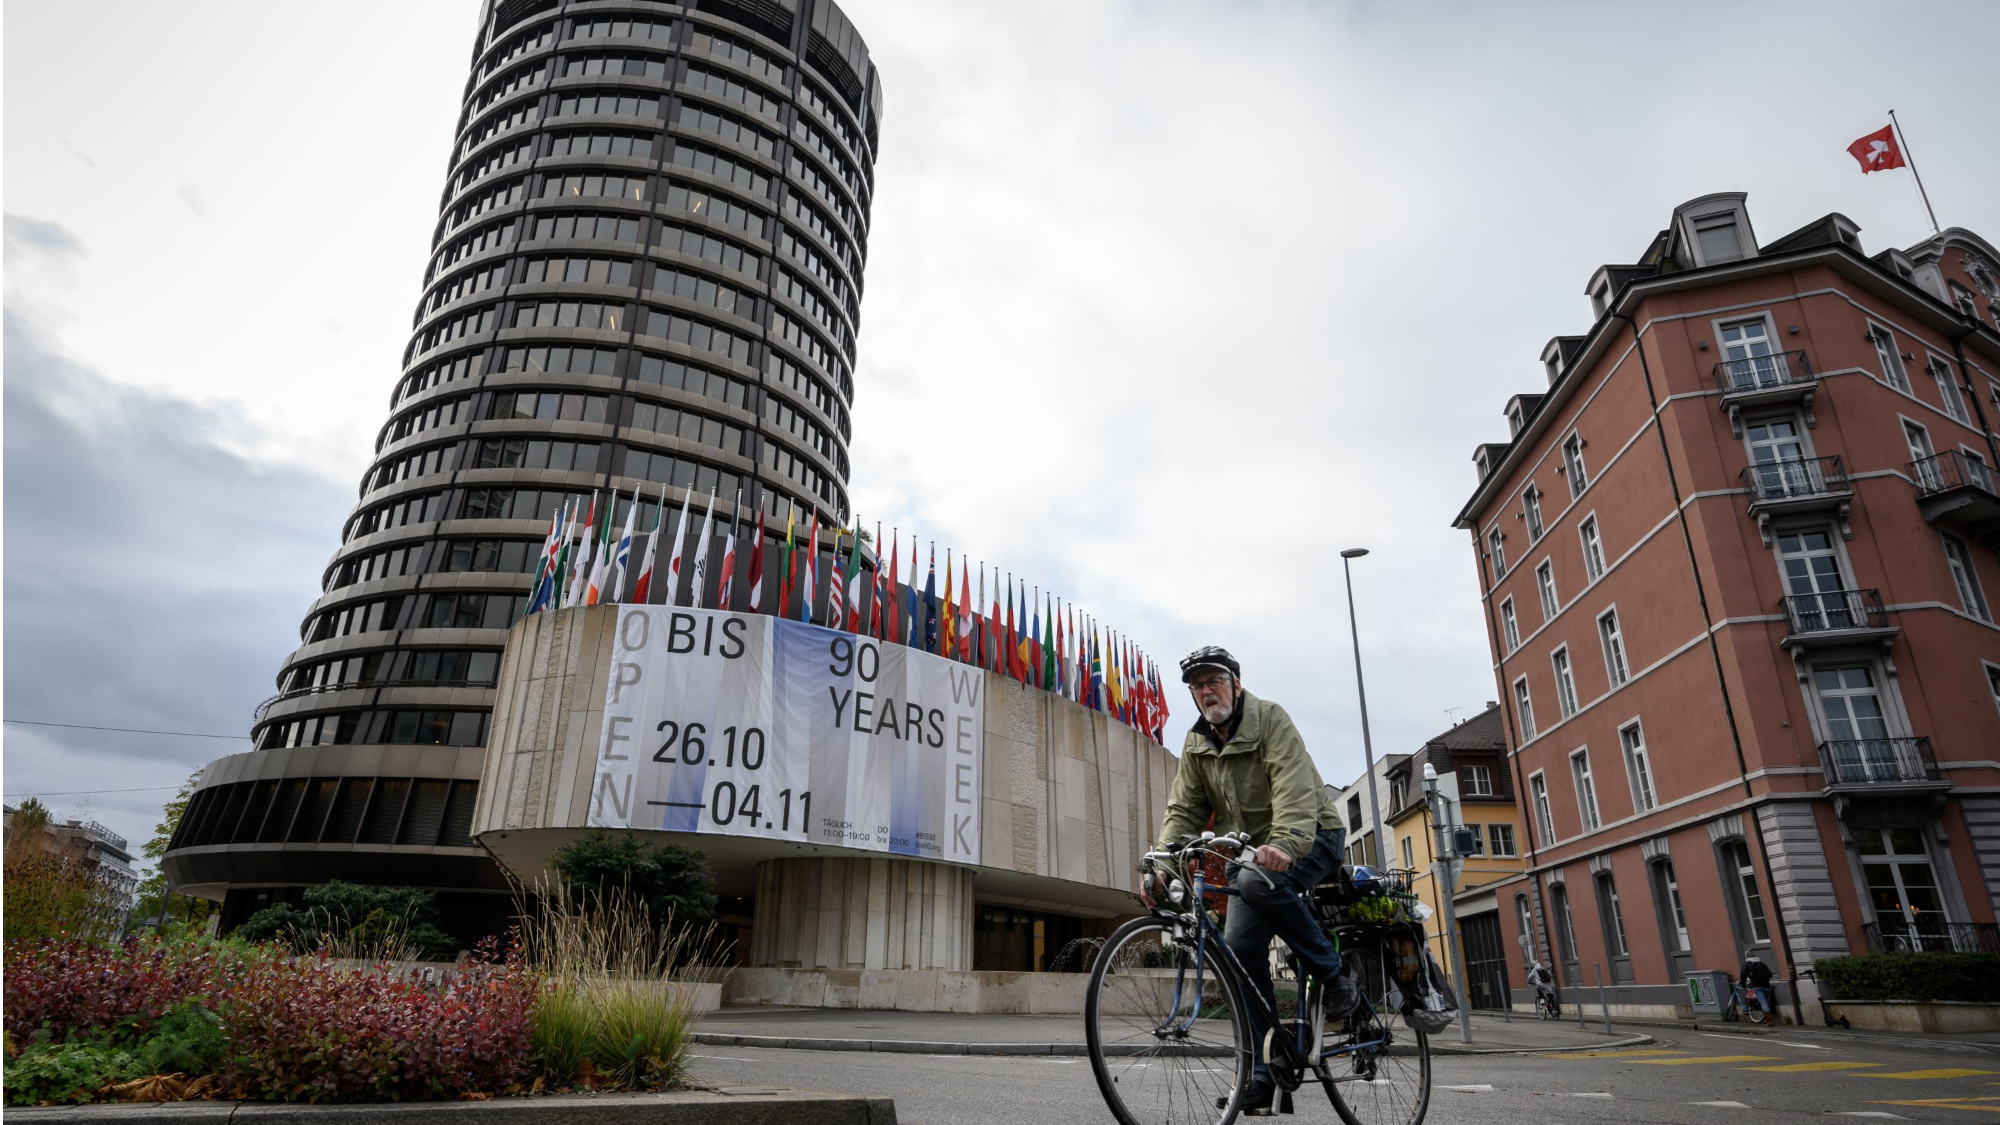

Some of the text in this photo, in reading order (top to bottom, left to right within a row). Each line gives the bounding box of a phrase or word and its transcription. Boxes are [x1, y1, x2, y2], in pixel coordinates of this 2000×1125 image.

[668, 612, 747, 660] BIS
[829, 636, 880, 683] 90
[597, 609, 649, 819] OPEN
[828, 685, 945, 749] YEARS
[652, 720, 765, 771] 26.10
[949, 665, 980, 855] WEEK
[877, 825, 889, 834] DO
[889, 837, 910, 846] 20:00
